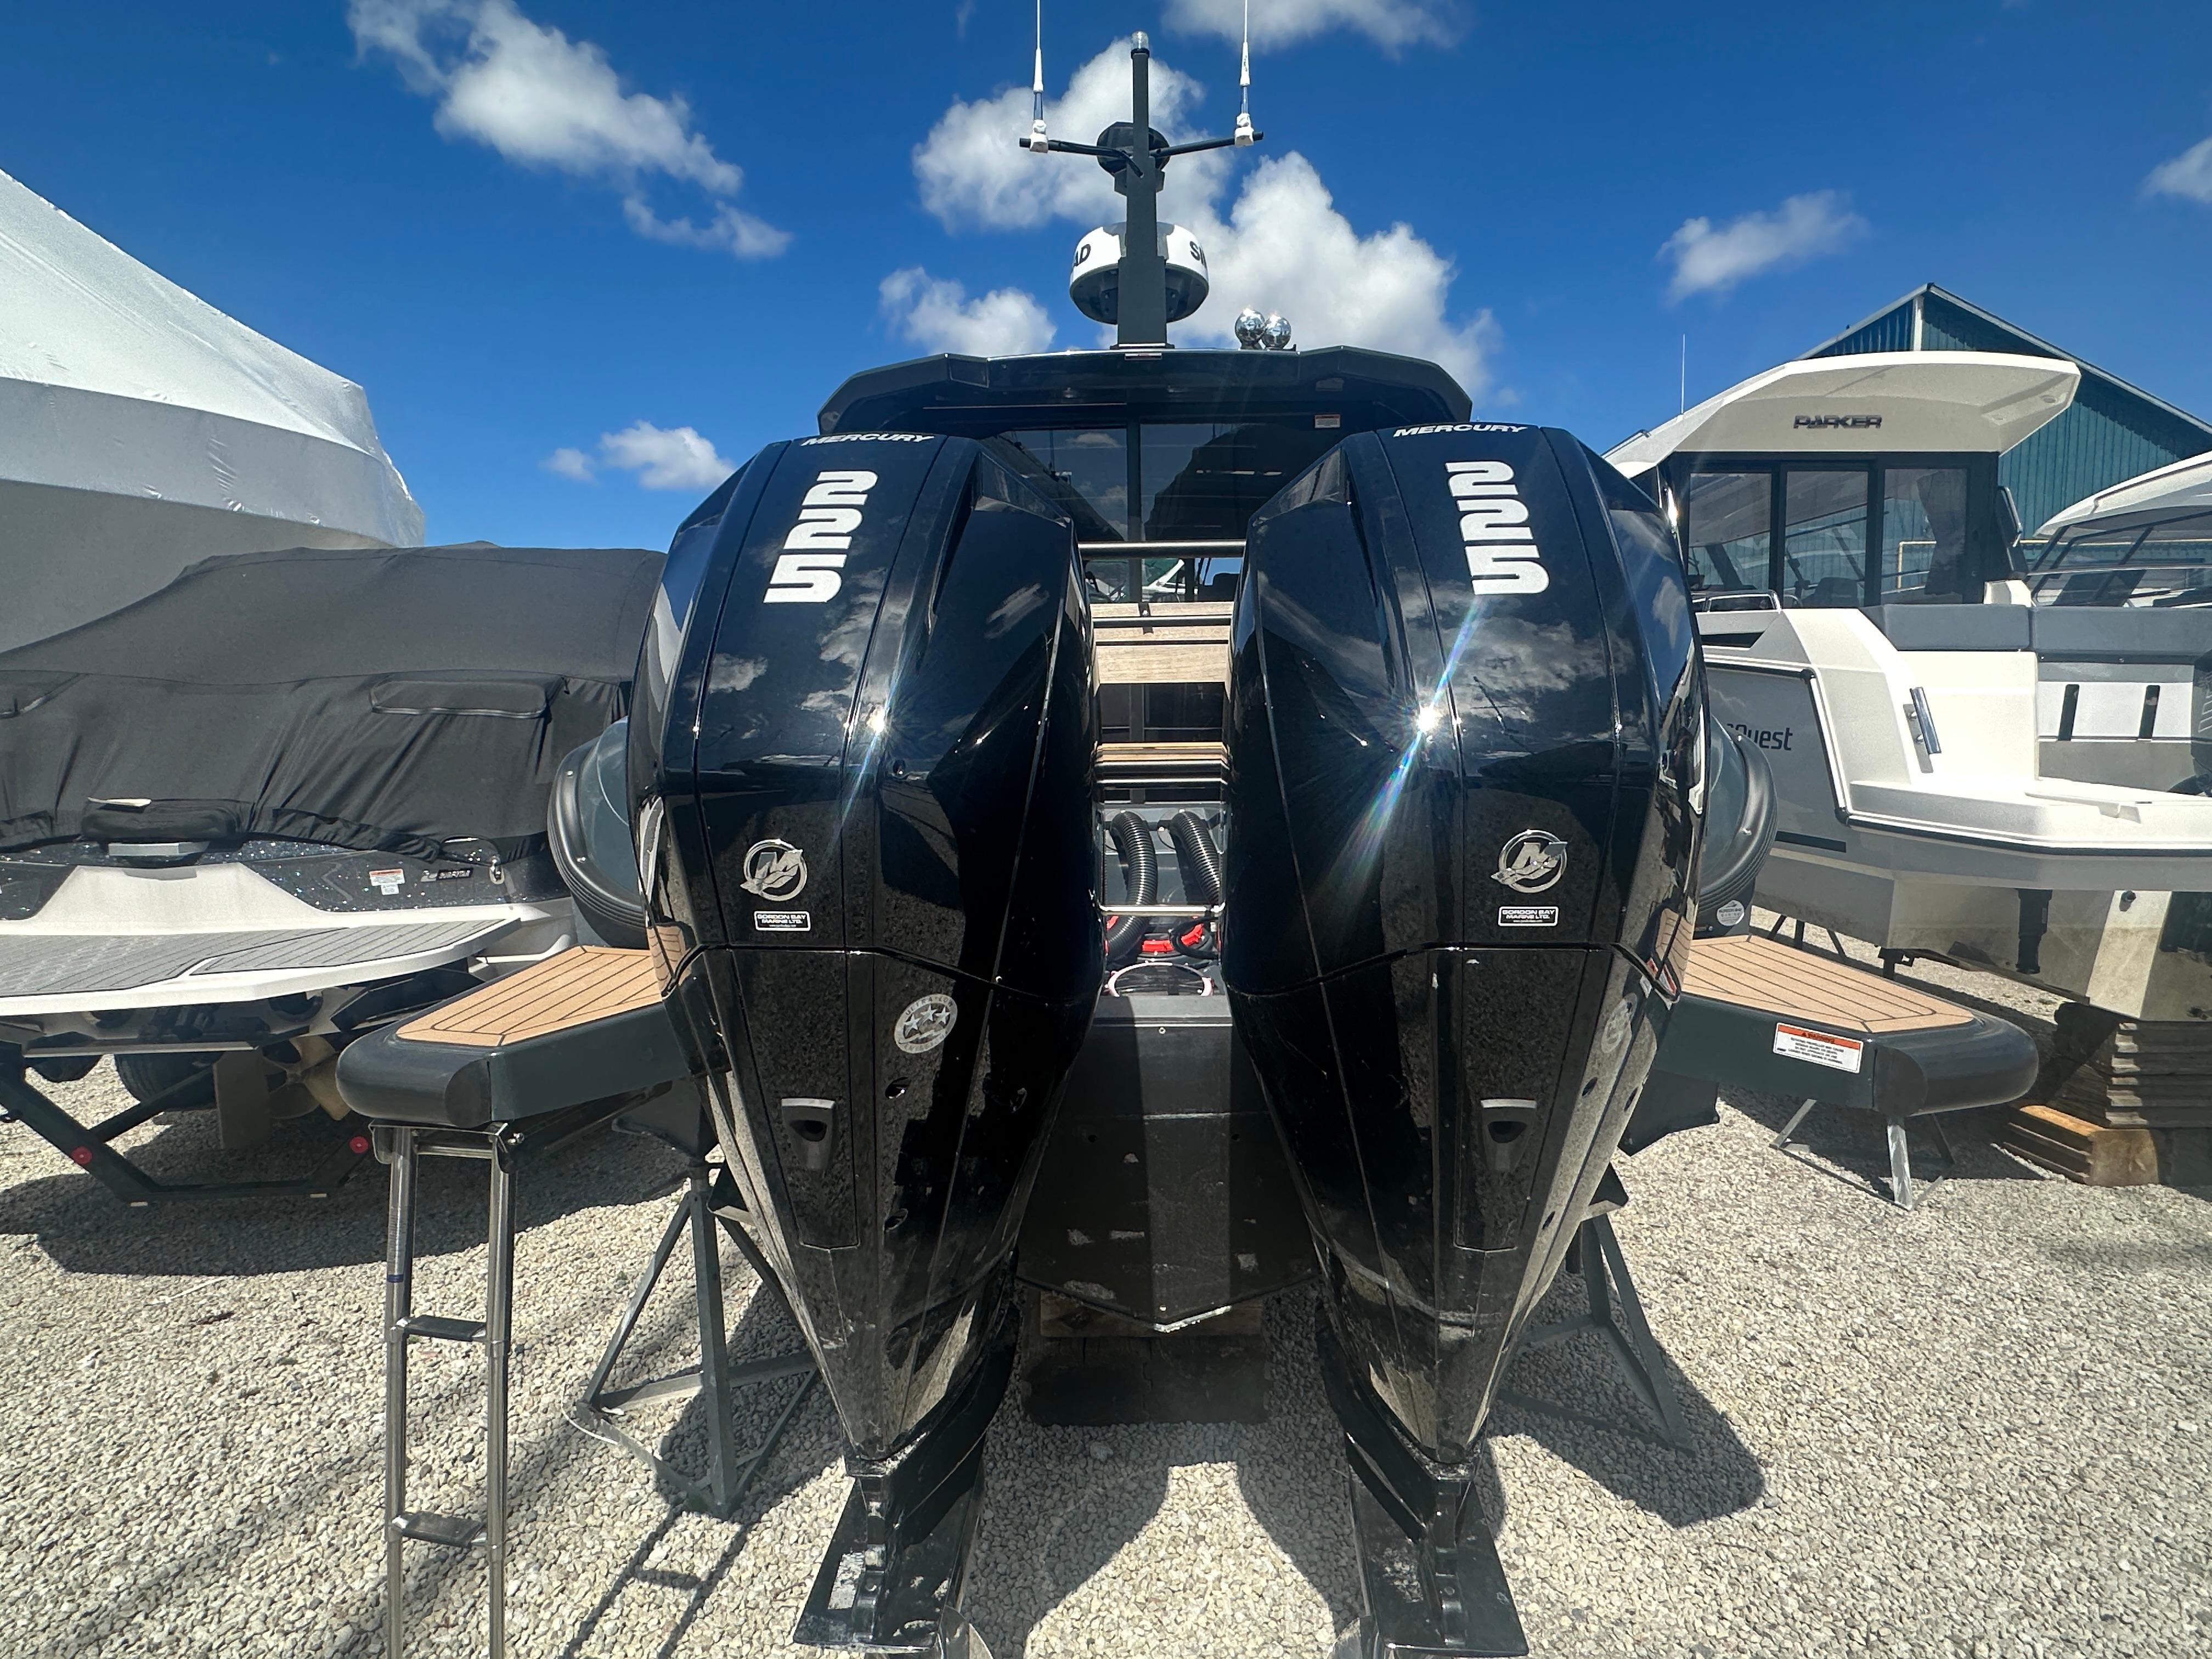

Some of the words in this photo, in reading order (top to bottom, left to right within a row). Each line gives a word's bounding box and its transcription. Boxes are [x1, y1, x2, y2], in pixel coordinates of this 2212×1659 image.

[1793, 415, 1882, 429] PARKER
[1393, 424, 1528, 438] MERCURY
[800, 433, 935, 447] MERCURY
[1444, 461, 1550, 595] 225
[763, 470, 878, 603] 225
